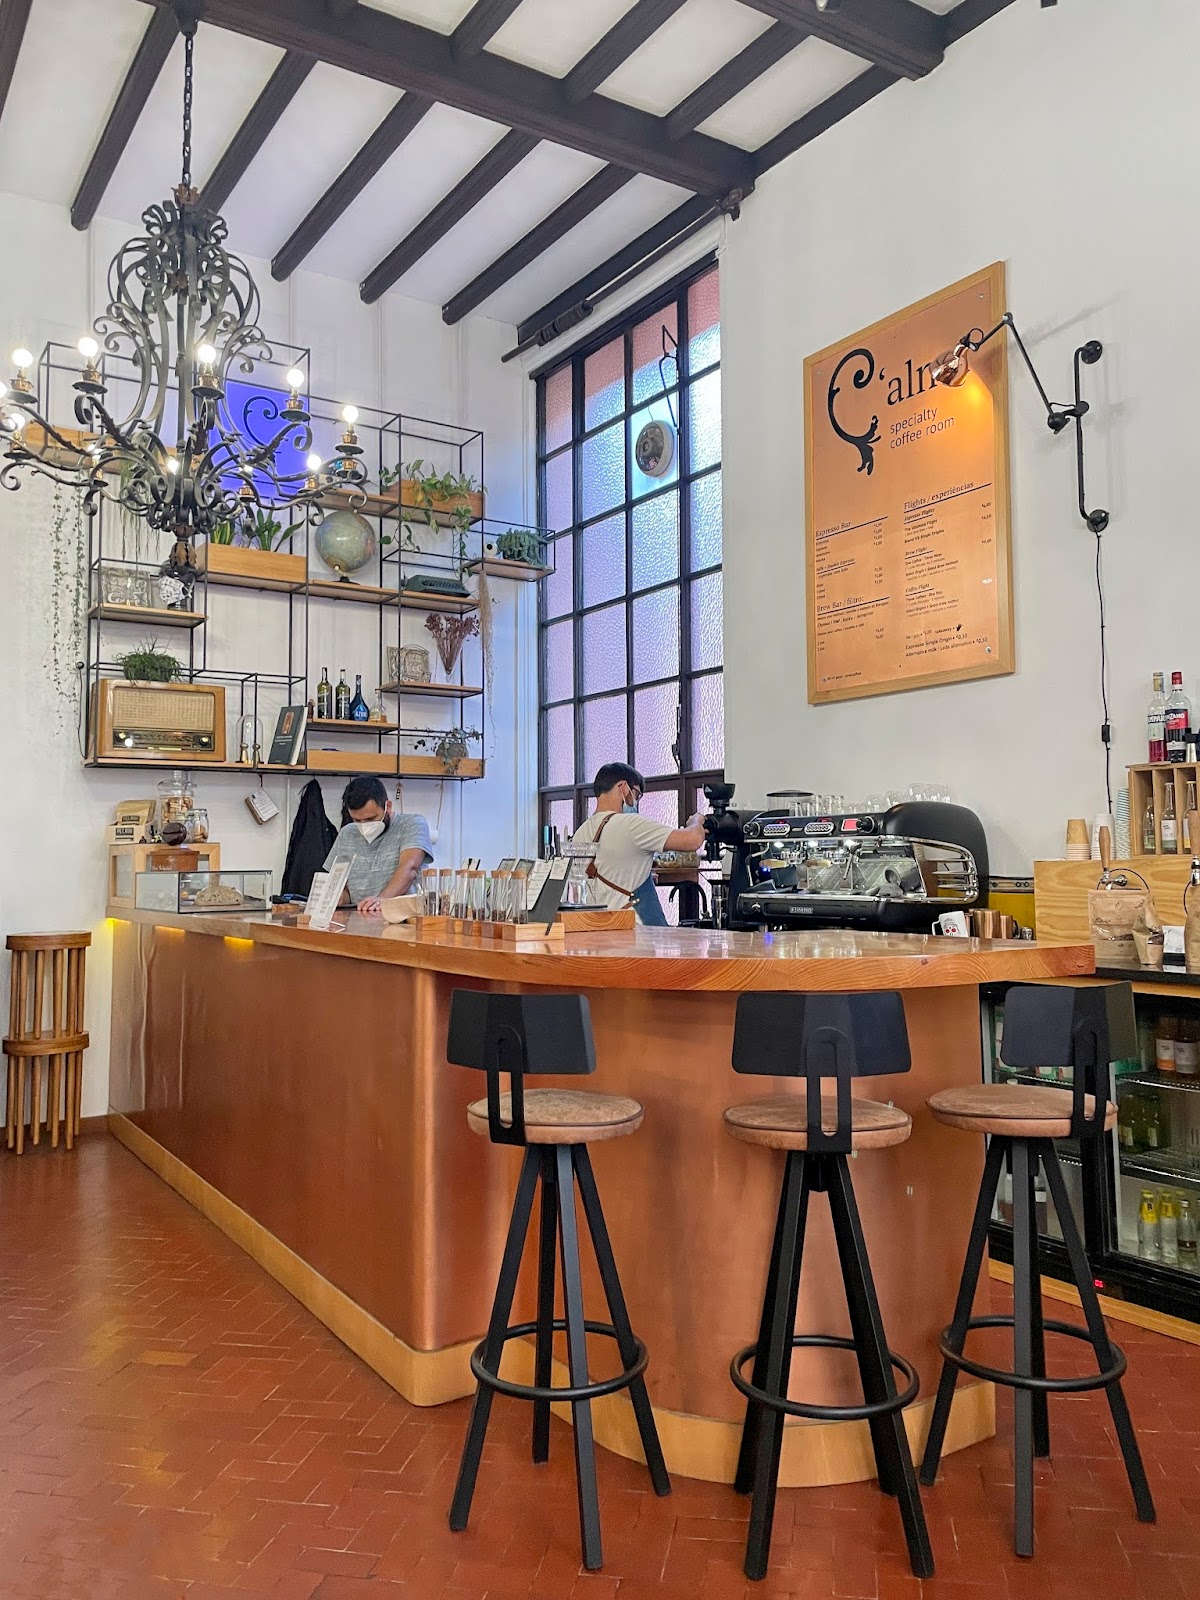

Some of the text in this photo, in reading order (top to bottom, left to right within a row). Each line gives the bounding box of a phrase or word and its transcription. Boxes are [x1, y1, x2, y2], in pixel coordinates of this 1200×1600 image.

[890, 408, 937, 435] specialty
[890, 417, 954, 449] coffee room
[904, 497, 926, 510] Flights
